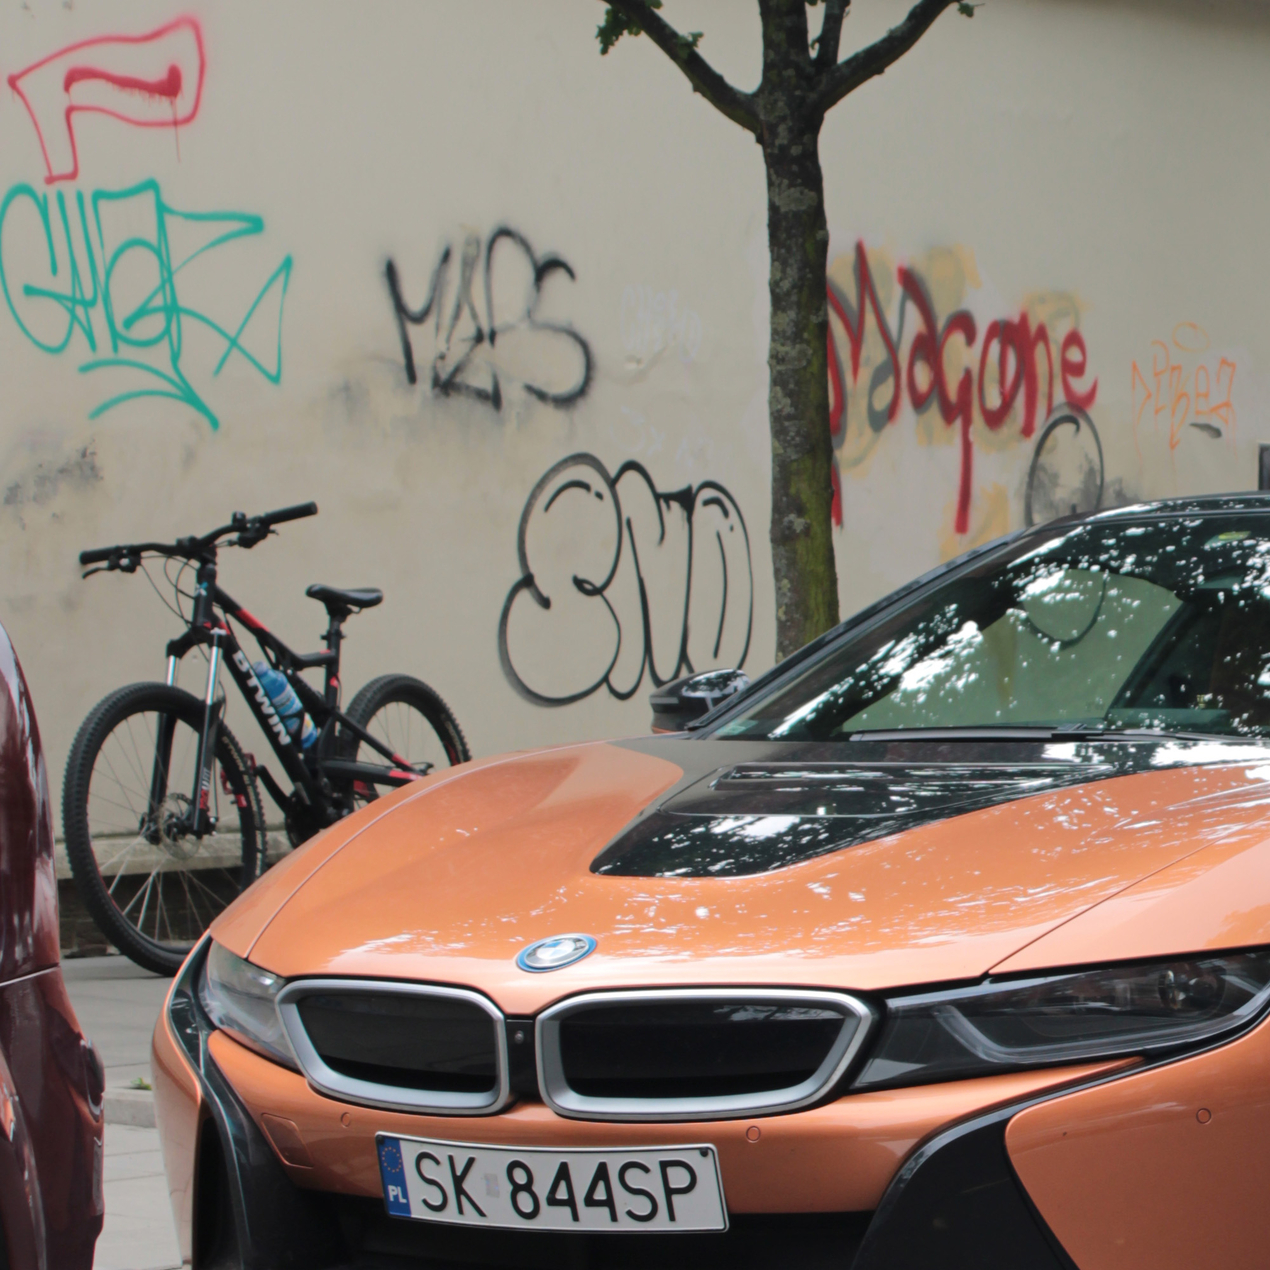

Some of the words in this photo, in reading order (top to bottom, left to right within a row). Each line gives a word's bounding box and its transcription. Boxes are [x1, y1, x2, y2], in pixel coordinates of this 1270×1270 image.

[388, 1185, 407, 1204] PL
[414, 1151, 488, 1218] SK
[506, 1159, 698, 1223] 844SP
